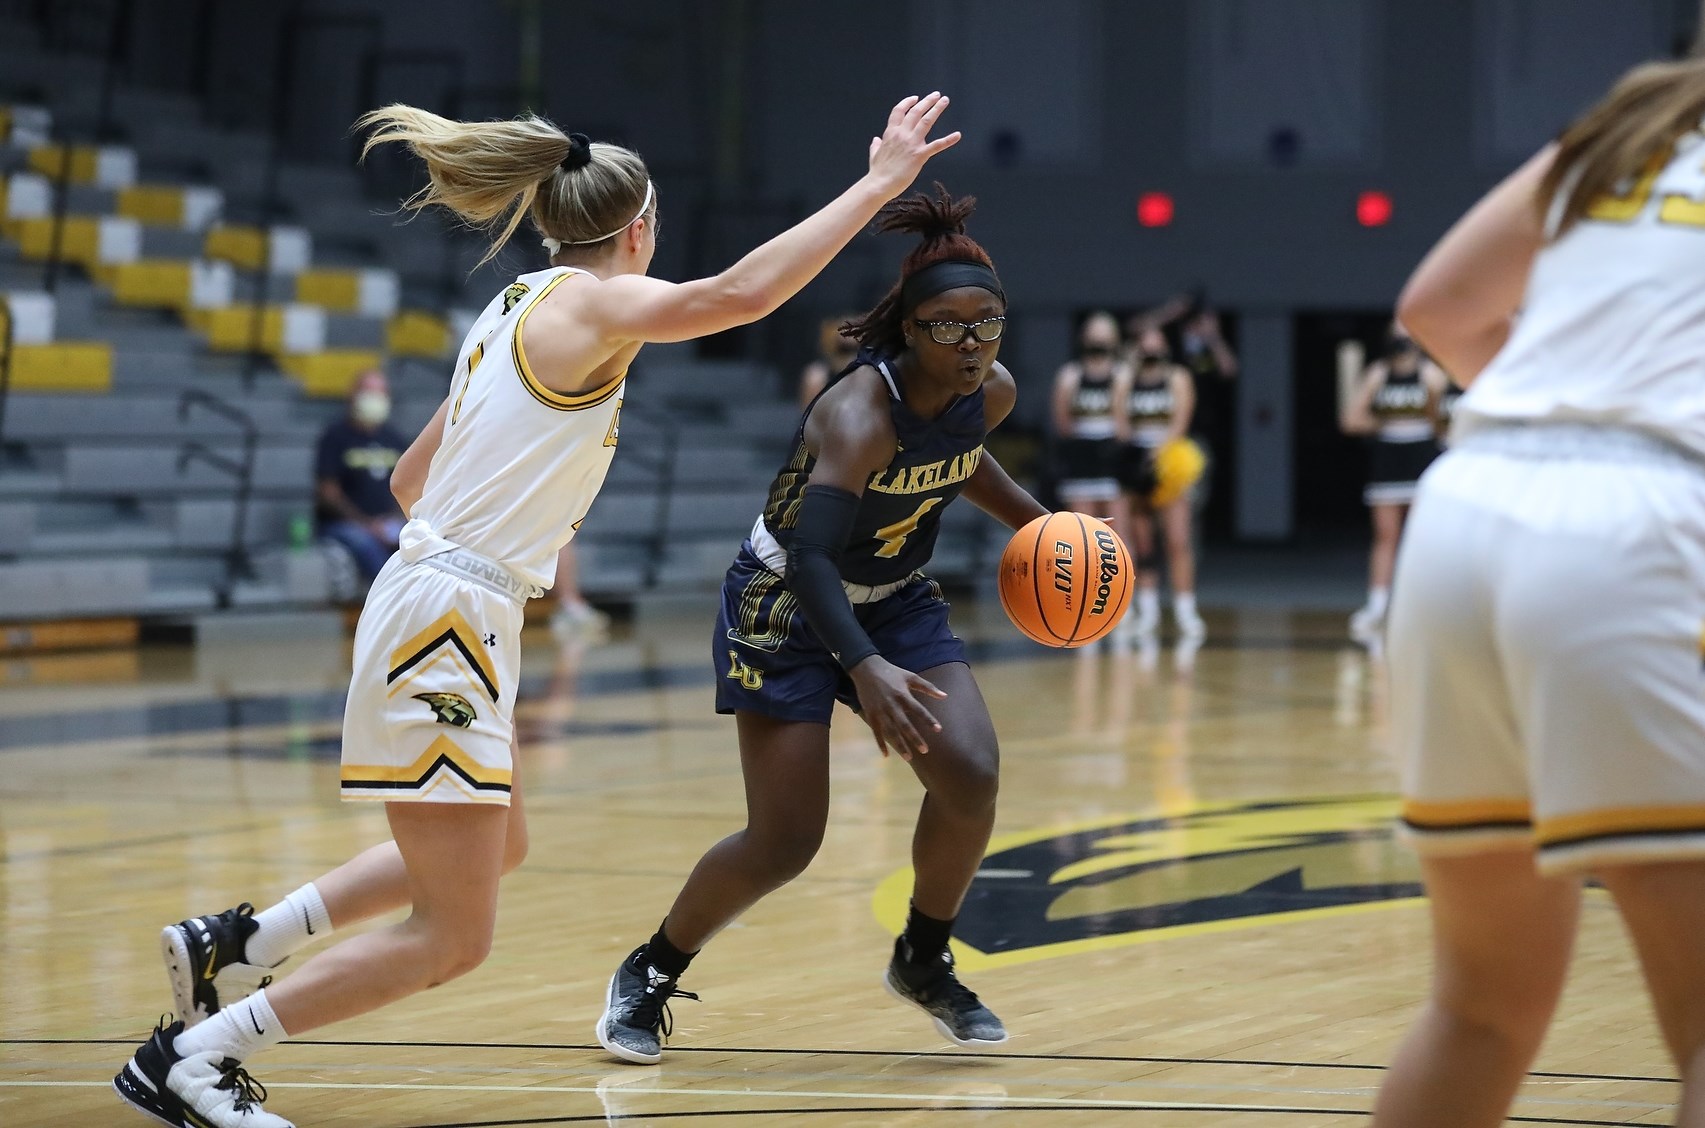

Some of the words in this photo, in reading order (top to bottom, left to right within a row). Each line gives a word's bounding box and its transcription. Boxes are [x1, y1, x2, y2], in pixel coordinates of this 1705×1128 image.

[873, 497, 943, 558] 4
[1091, 530, 1118, 615] Wilson
[727, 651, 764, 690] LU
